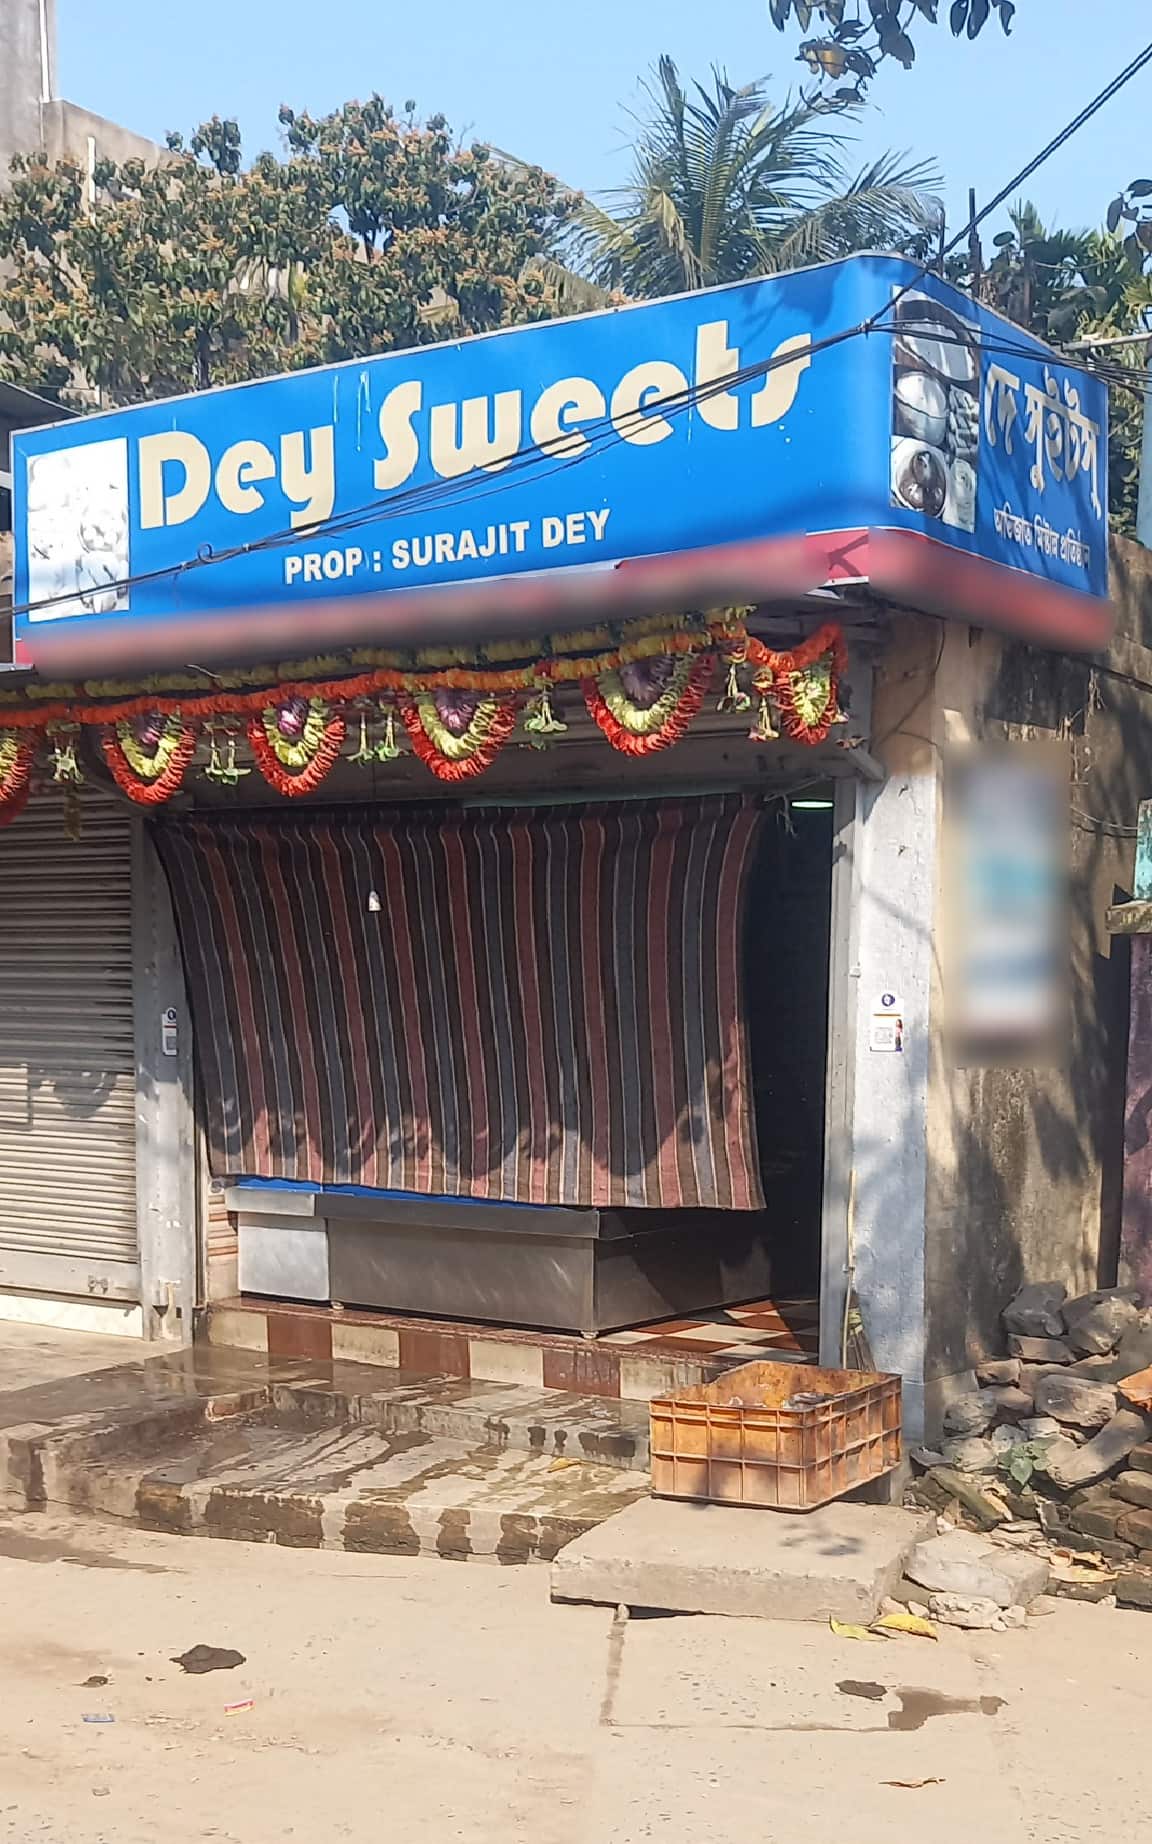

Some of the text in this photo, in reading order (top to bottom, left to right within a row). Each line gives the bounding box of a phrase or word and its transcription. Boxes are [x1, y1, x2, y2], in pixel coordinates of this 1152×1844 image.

[139, 321, 812, 537] Dey Sweets
[984, 362, 1020, 456] দে
[284, 548, 362, 585] PROP
[392, 521, 530, 570] SURAJIT
[542, 509, 610, 548] DEY
